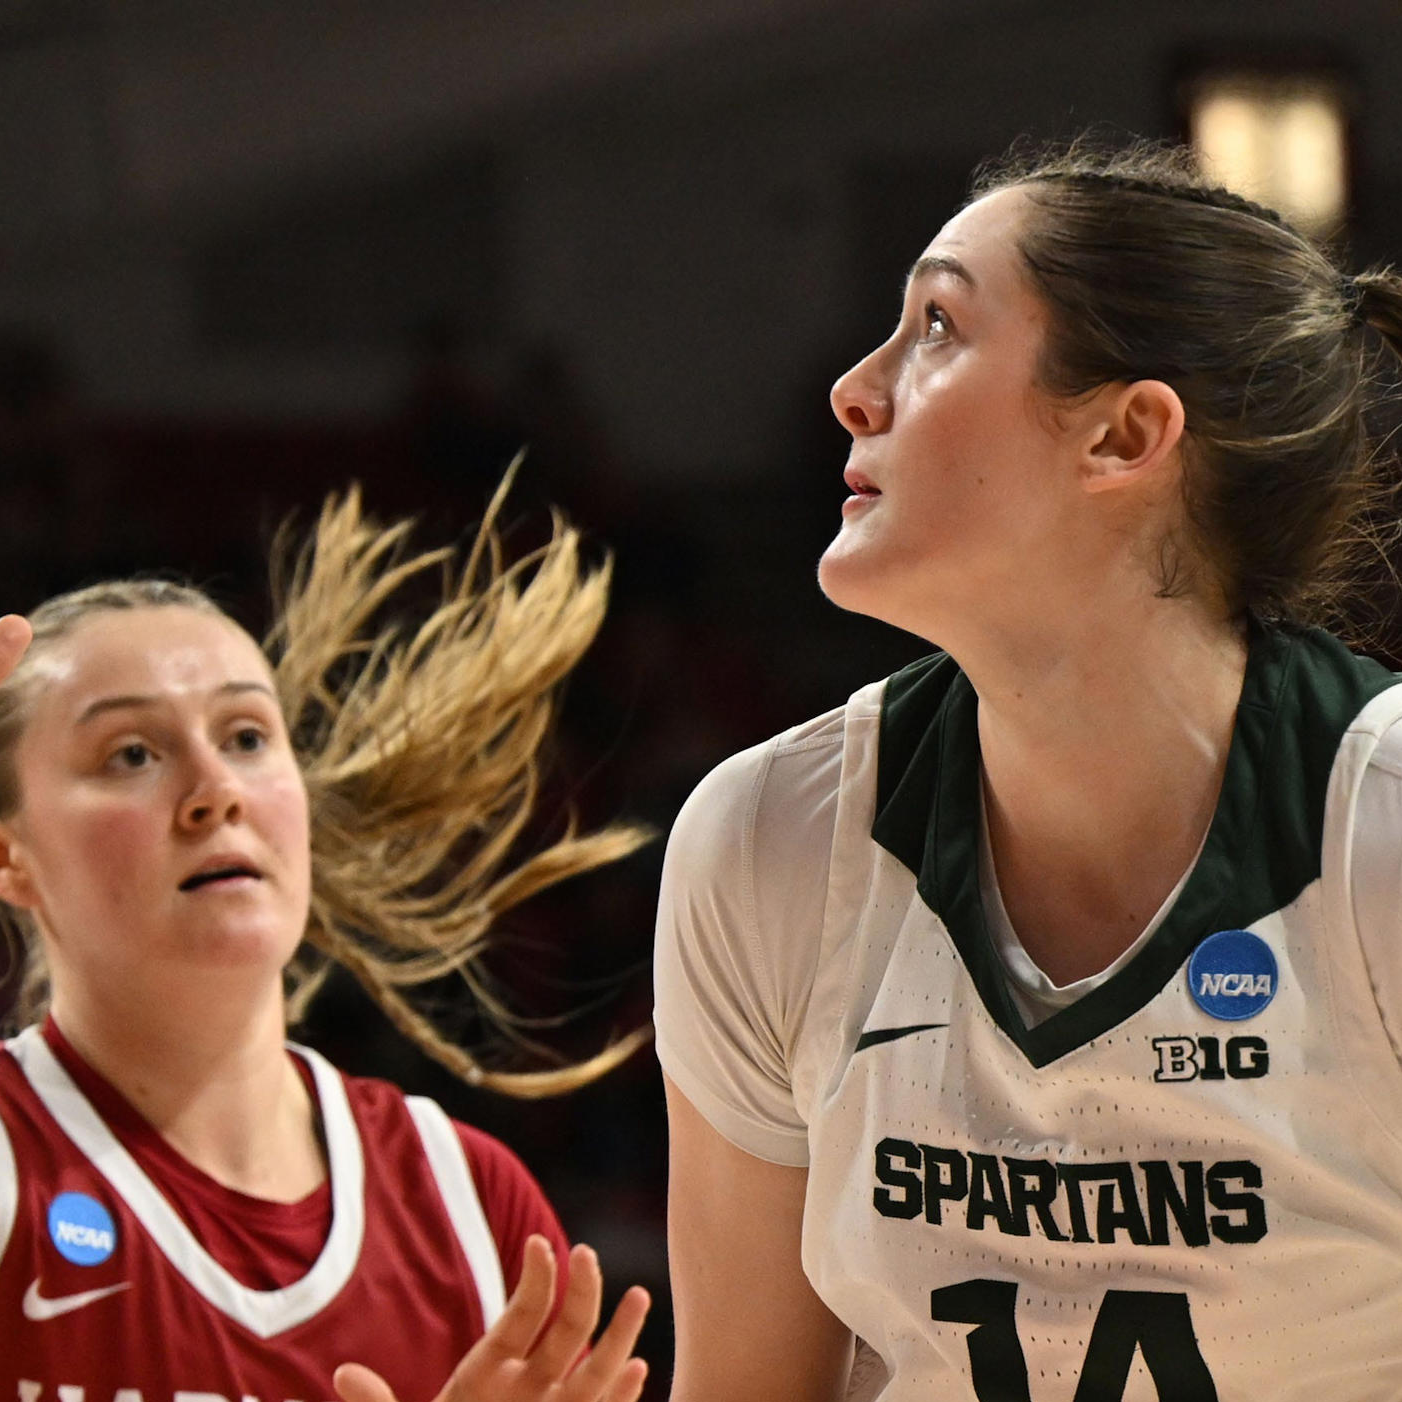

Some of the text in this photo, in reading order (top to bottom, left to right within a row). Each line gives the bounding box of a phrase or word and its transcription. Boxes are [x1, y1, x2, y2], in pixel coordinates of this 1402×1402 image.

[1200, 973, 1271, 996] NCAA
[873, 1137, 1268, 1247] SPARTANS
[55, 1221, 113, 1252] NCAA
